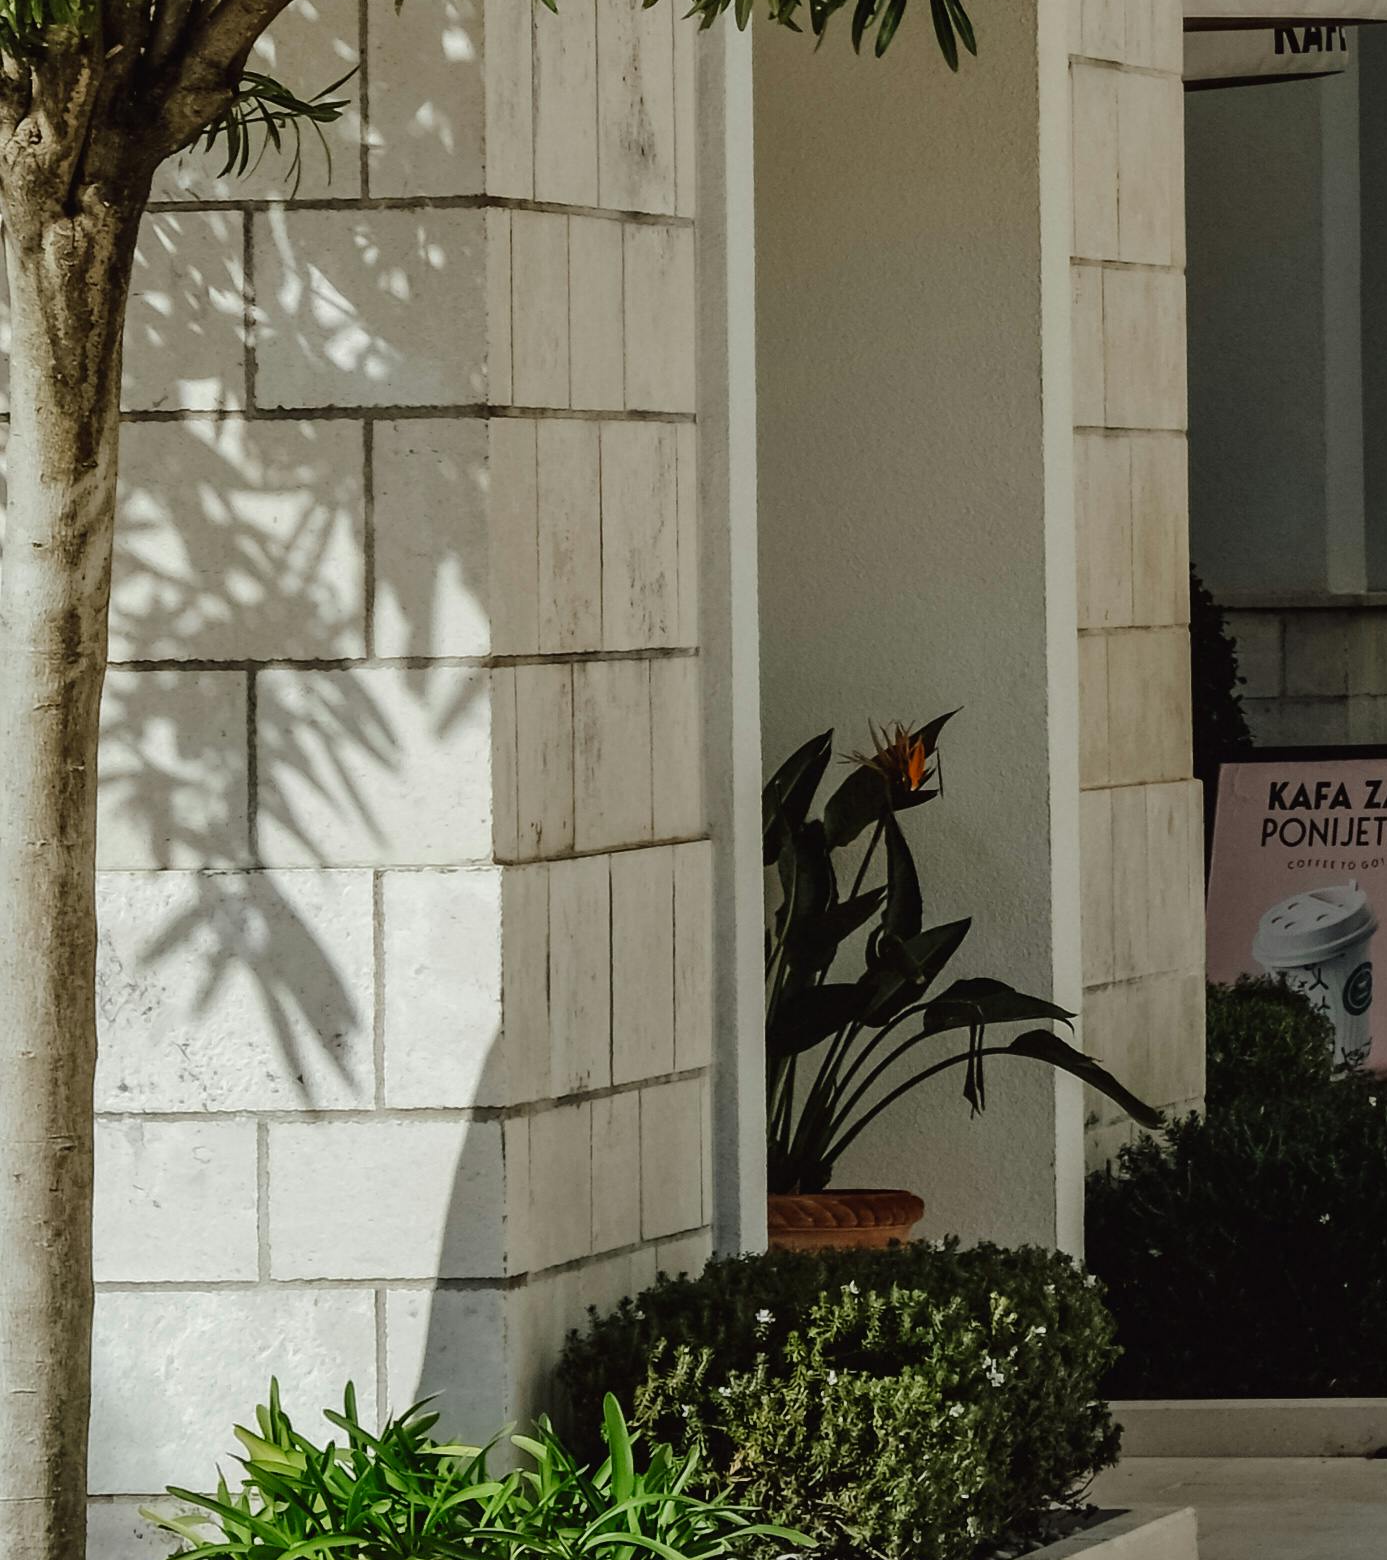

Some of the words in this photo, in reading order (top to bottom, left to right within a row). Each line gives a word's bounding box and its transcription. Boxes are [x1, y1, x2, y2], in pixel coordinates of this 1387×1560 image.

[1268, 781, 1352, 810] KAFA
[1287, 859, 1336, 870] COFFEE
[1341, 861, 1357, 870] TO
